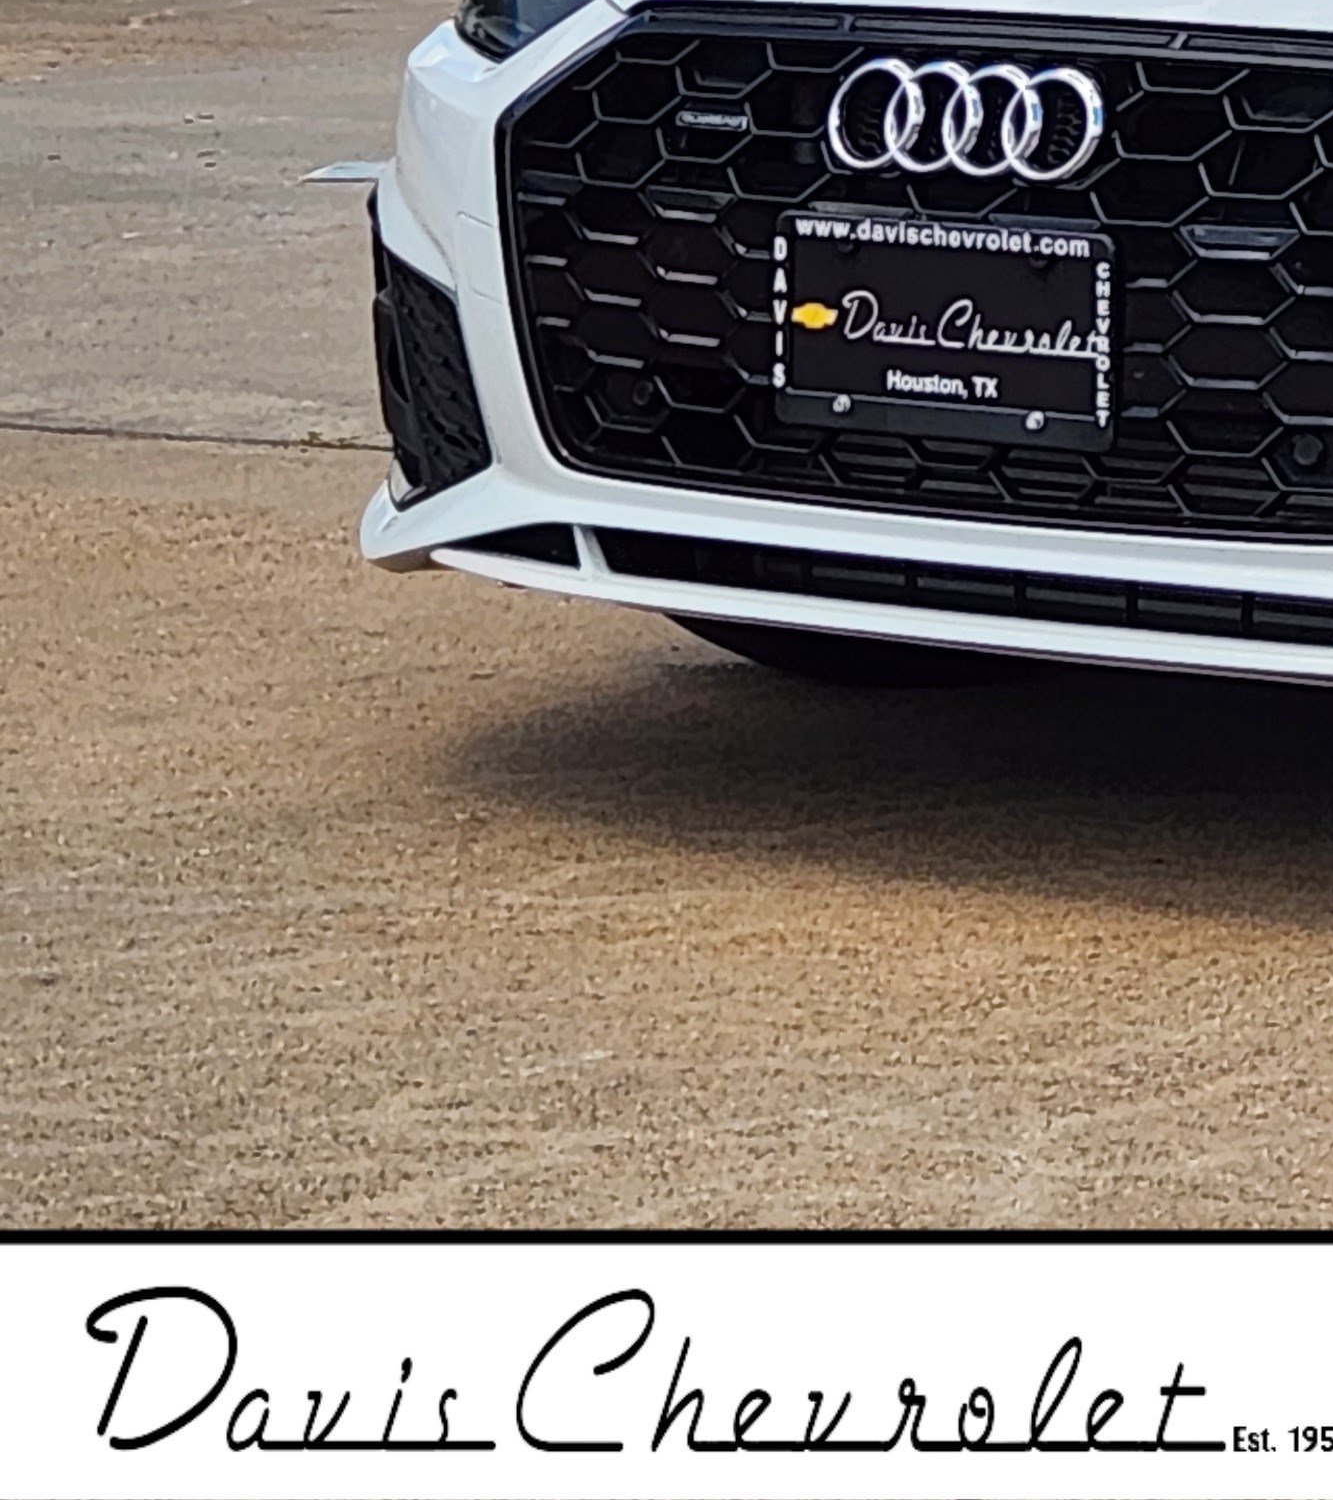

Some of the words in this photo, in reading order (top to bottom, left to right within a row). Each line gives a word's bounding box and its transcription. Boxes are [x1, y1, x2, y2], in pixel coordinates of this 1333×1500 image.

[795, 216, 1092, 258] www.davischevrolet.com
[842, 289, 937, 346] Davis
[886, 369, 968, 400] Houston,
[971, 375, 999, 399] TX
